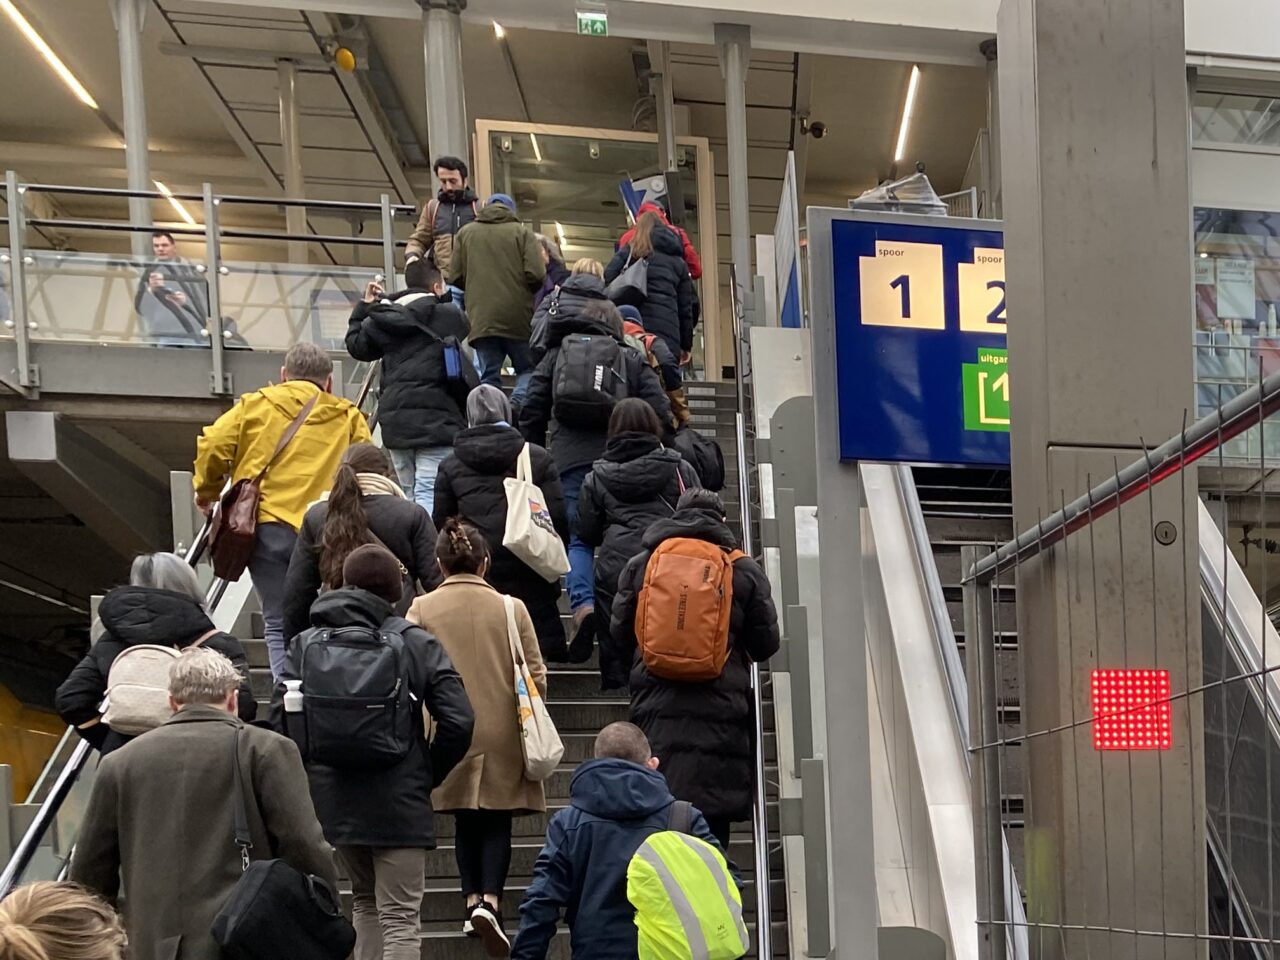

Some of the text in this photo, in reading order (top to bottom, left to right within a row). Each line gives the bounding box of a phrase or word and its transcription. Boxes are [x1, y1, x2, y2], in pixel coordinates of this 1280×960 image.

[878, 248, 904, 257] spoor
[977, 255, 1003, 264] spoor
[889, 274, 911, 319] 1
[986, 280, 1008, 324] 2
[593, 364, 604, 391] THULE
